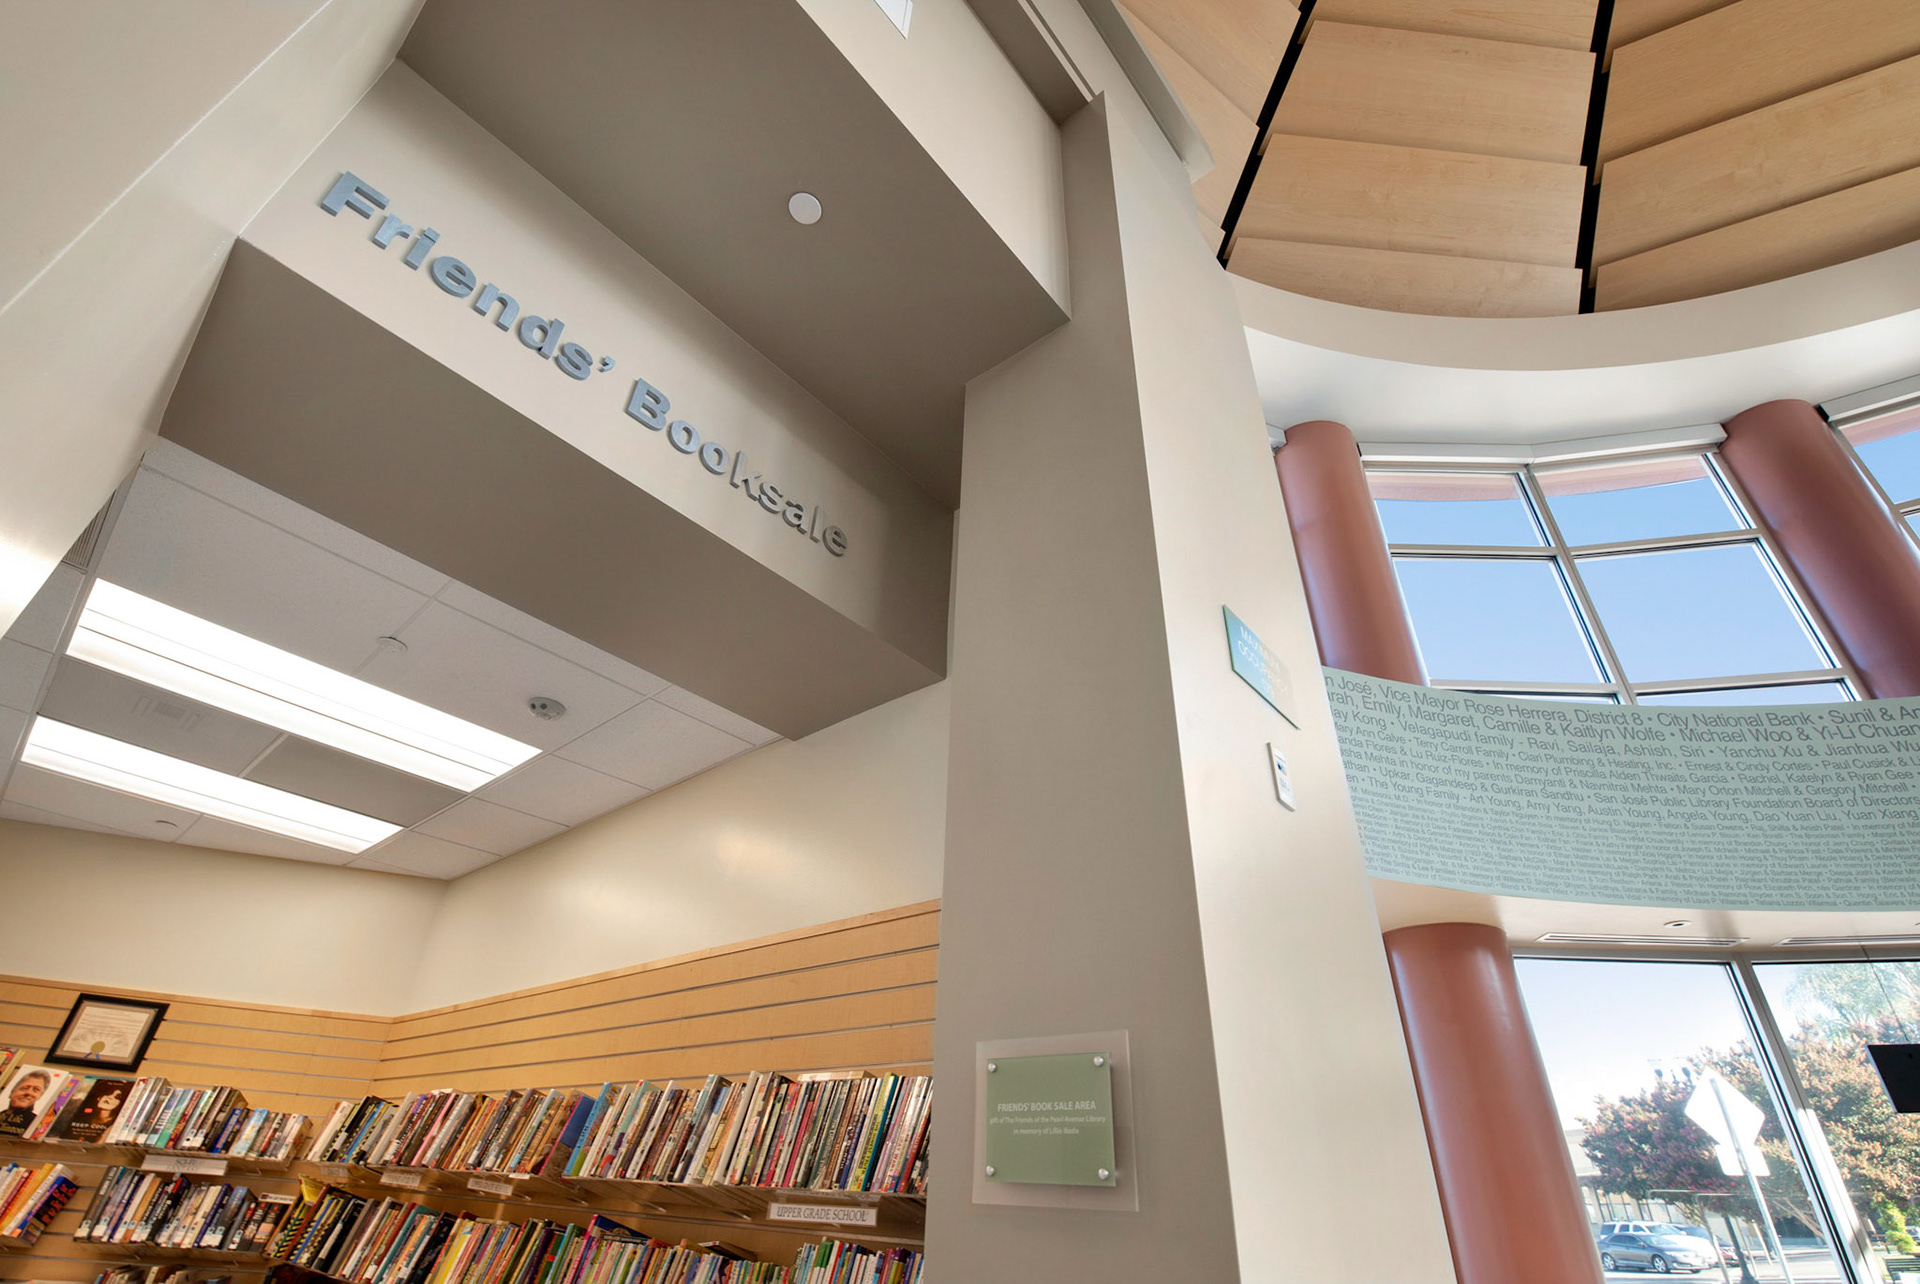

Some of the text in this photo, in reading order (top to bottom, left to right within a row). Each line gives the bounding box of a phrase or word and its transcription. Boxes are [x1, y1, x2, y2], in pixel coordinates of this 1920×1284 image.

[624, 378, 849, 557] Booksale
[1327, 691, 1358, 710] rah,
[1362, 696, 1405, 718] Emily,
[1408, 705, 1480, 730] Margaret,
[1482, 716, 1540, 734] Camille
[1546, 722, 1558, 735] &
[1560, 722, 1615, 742] Kaitlyn
[1616, 727, 1666, 740] Wolfe
[1678, 728, 1746, 742] Michael
[1748, 728, 1792, 742] Woo
[1796, 727, 1811, 741] &
[1812, 725, 1855, 740] Yi-Li
[1338, 677, 1376, 699] José,
[1378, 684, 1410, 702] Vice
[1414, 692, 1460, 711] Mayor
[1464, 699, 1504, 716] Rose
[1507, 704, 1572, 724] Herrera,
[1574, 709, 1629, 726] District
[1632, 713, 1643, 726] 8
[1657, 713, 1688, 730] City
[1692, 713, 1764, 727] National
[1766, 712, 1815, 726] Bank
[1828, 709, 1876, 724] Sunil
[1880, 707, 1896, 721] &
[1352, 710, 1387, 731] Kong
[1398, 720, 1471, 743] Velagapudi
[1475, 731, 1513, 749] family
[1528, 737, 1564, 753] Ravi,
[1566, 740, 1620, 757] Sailaja,
[1624, 744, 1676, 758] Ashish,
[1680, 746, 1705, 758] Siri
[1717, 746, 1776, 758] Yanchu
[1779, 746, 1802, 758] Xu
[1807, 745, 1820, 756] &
[1824, 743, 1889, 756] Jianhua
[1890, 741, 1920, 752] Wu
[1356, 726, 1376, 739] Ann
[1378, 731, 1406, 744] Calve
[1414, 737, 1438, 751] Terry
[1441, 742, 1473, 754] Carroll
[1475, 746, 1509, 761] Family
[1545, 754, 1595, 769] Plumbing
[1596, 757, 1604, 767] &
[1608, 758, 1654, 771] Heating,
[1656, 760, 1676, 770] Inc.
[1685, 761, 1721, 771] Ernest
[1725, 762, 1734, 770] &
[1736, 761, 1769, 773] Cindy
[1772, 761, 1812, 771] Cortes
[1822, 760, 1850, 770] Paul
[1852, 758, 1896, 769] Cusick
[1898, 757, 1908, 766] &
[1365, 739, 1397, 754] Flores
[1399, 747, 1407, 756] &
[1410, 748, 1423, 758] Lu
[1426, 751, 1483, 768] Ruiz-Flores
[1492, 761, 1503, 770] In
[1506, 762, 1549, 777] memory
[1552, 766, 1561, 776] of
[1565, 766, 1607, 778] Priscilla
[1610, 771, 1640, 781] Alden
[1642, 772, 1687, 782] Thwaits
[1689, 773, 1728, 783] Garcia
[1738, 773, 1784, 784] Rachel,
[1786, 773, 1832, 785] Katelyn
[1836, 773, 1845, 781] &
[1848, 772, 1882, 783] Ryan
[1884, 770, 1913, 780] Gee
[1365, 751, 1396, 766] Mehta
[1399, 759, 1408, 768] in
[1411, 761, 1438, 773] honor
[1442, 764, 1451, 774] of
[1456, 768, 1470, 779] my
[1474, 771, 1513, 784] parents
[1514, 774, 1566, 788] Damyanti
[1570, 779, 1576, 788] &
[1630, 783, 1667, 793] Mehta
[1677, 785, 1706, 798] Mary
[1709, 785, 1742, 795] Orton
[1744, 786, 1791, 796] Mitchell
[1793, 786, 1802, 795] &
[1805, 785, 1855, 797] Gregory
[1859, 782, 1909, 794] Mitchell
[1368, 776, 1388, 789] The
[1390, 781, 1424, 798] Young
[1426, 786, 1459, 803] Family
[1470, 794, 1484, 804] Art
[1487, 795, 1524, 811] Young,
[1527, 800, 1550, 813] Amy
[1552, 802, 1585, 816] Yang,
[1588, 805, 1622, 816] Austin
[1623, 808, 1664, 821] Young,
[1667, 810, 1707, 822] Angela
[1708, 810, 1752, 823] Young,
[1753, 811, 1779, 821] Dao
[1780, 810, 1815, 820] Yuan
[1816, 810, 1841, 822] Liu,
[1841, 810, 1877, 820] Yuan
[1880, 808, 1919, 821] Xiang
[1380, 767, 1414, 781] Upkar,
[1416, 772, 1477, 792] Gagandeep
[1481, 782, 1489, 791] &
[1491, 784, 1538, 797] Gurkiran
[1541, 788, 1584, 801] Sandhu
[1593, 793, 1617, 802] San
[1622, 794, 1648, 805] José
[1651, 796, 1687, 807] Public
[1690, 798, 1729, 810] Library
[1732, 798, 1802, 808] Foundation
[1804, 798, 1844, 807] Board
[1847, 797, 1858, 807] of
[1031, 1102, 1052, 1111] BOOK
[1054, 1101, 1073, 1110] SALE
[1075, 1100, 1096, 1110] AREA
[1086, 1115, 1106, 1123] Library
[777, 1206, 866, 1222] UPPER GRADE SCHOOL
